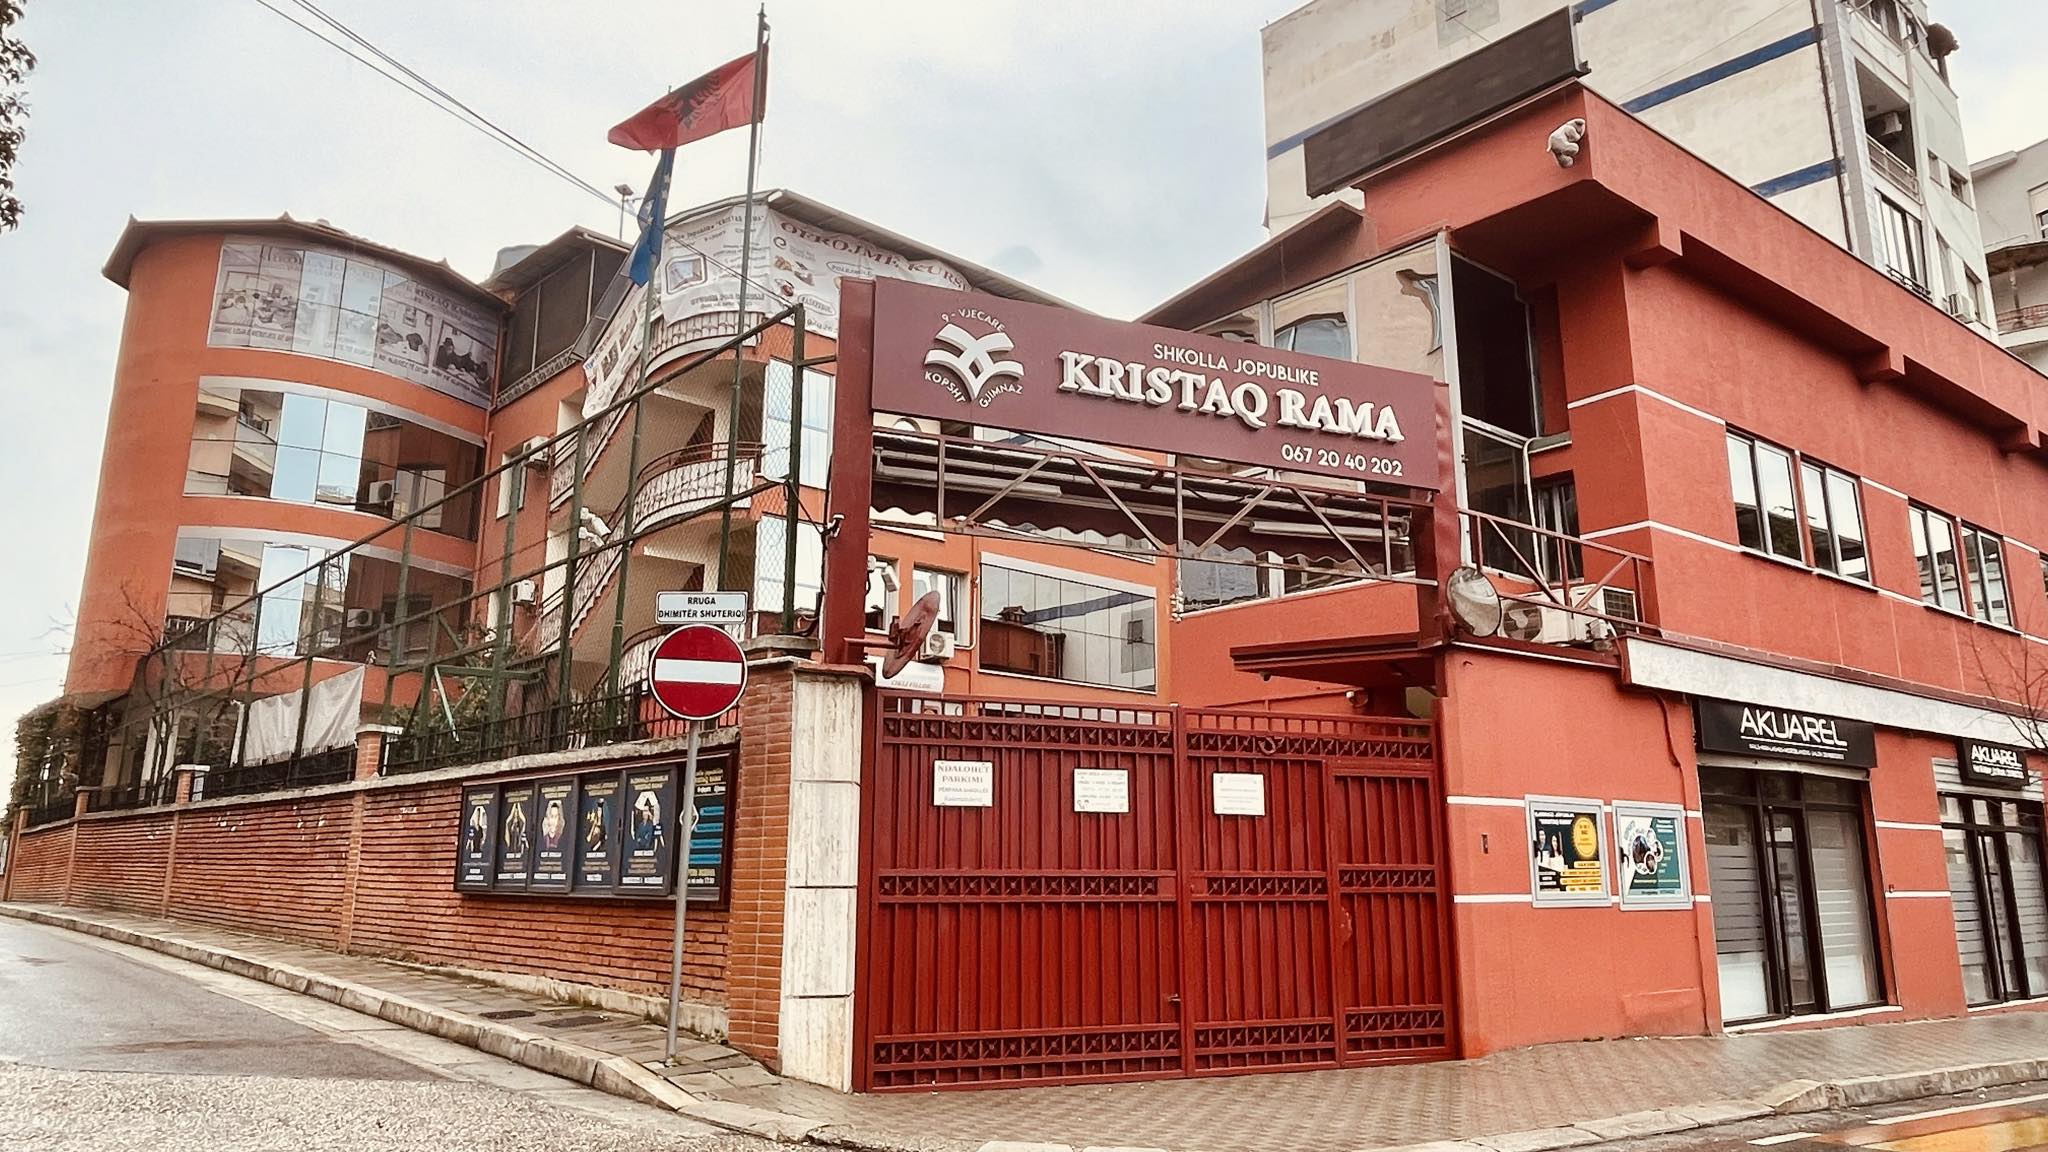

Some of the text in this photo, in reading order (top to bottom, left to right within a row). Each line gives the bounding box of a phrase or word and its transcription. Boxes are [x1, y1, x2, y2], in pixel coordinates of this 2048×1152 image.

[958, 309, 1006, 333] VJECARE
[1153, 343, 1319, 387] SHKOLLA JOPUBLIKE
[925, 371, 967, 403] KOPSHT
[978, 383, 1024, 408] GJIMNAZ
[1058, 349, 1405, 443] KRISTAQ RAMA
[1281, 444, 1404, 478] 067 20 40 202
[687, 597, 716, 606] RRUGA
[1740, 707, 1848, 747] AKUAREL
[1971, 744, 2023, 768] AKUAREL
[938, 764, 989, 774] NDALOHET
[942, 775, 983, 784] PARKIMI
